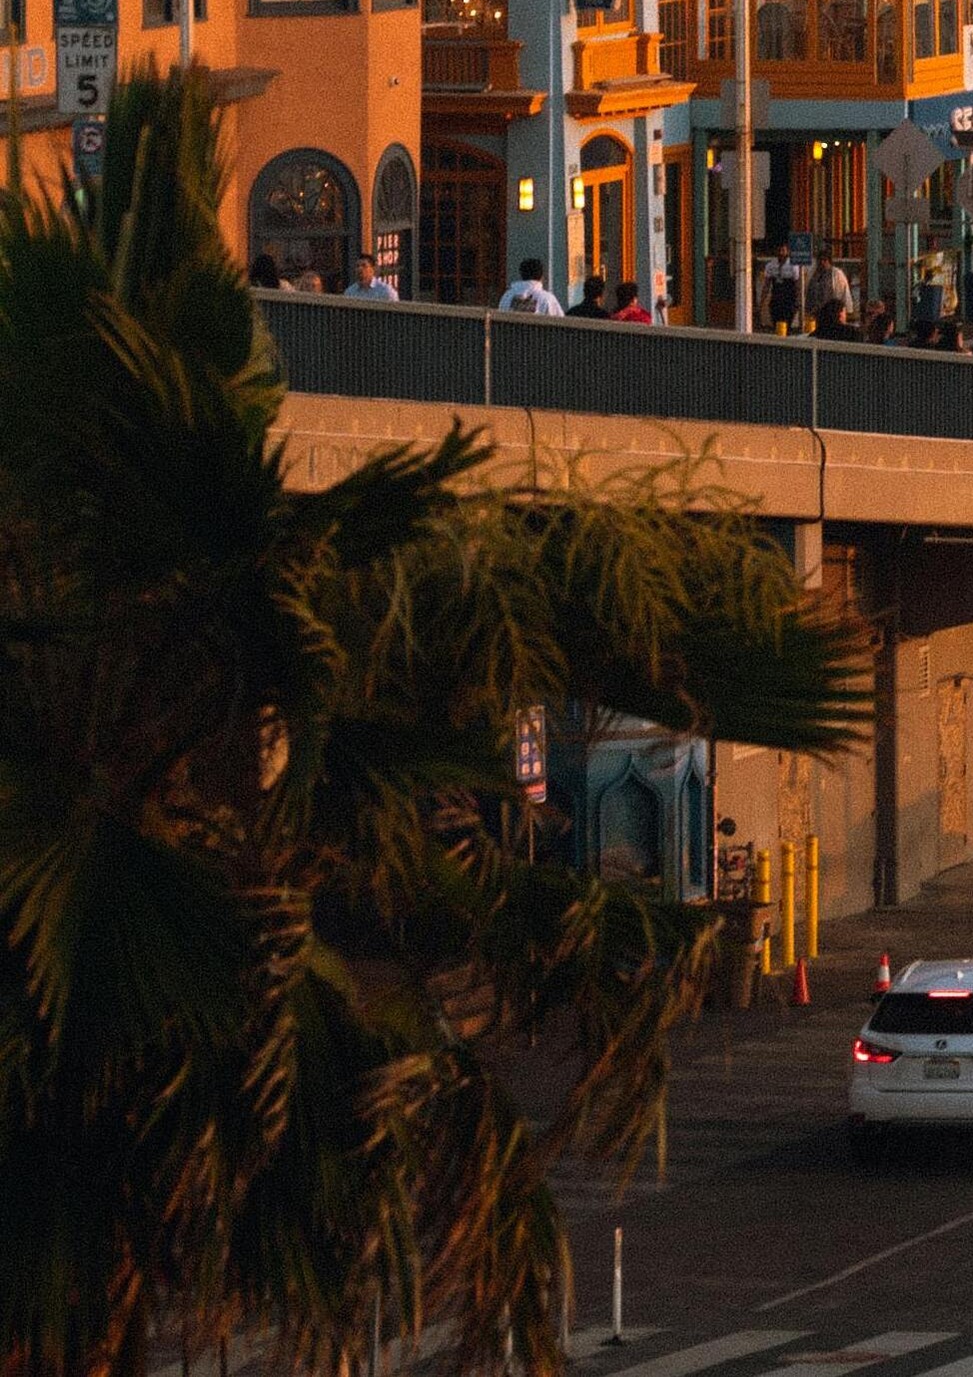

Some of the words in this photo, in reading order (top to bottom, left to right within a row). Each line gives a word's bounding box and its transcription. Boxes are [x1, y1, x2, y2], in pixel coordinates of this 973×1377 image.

[60, 34, 113, 48] SPEED
[65, 54, 109, 68] LIMIT
[78, 75, 98, 107] 5
